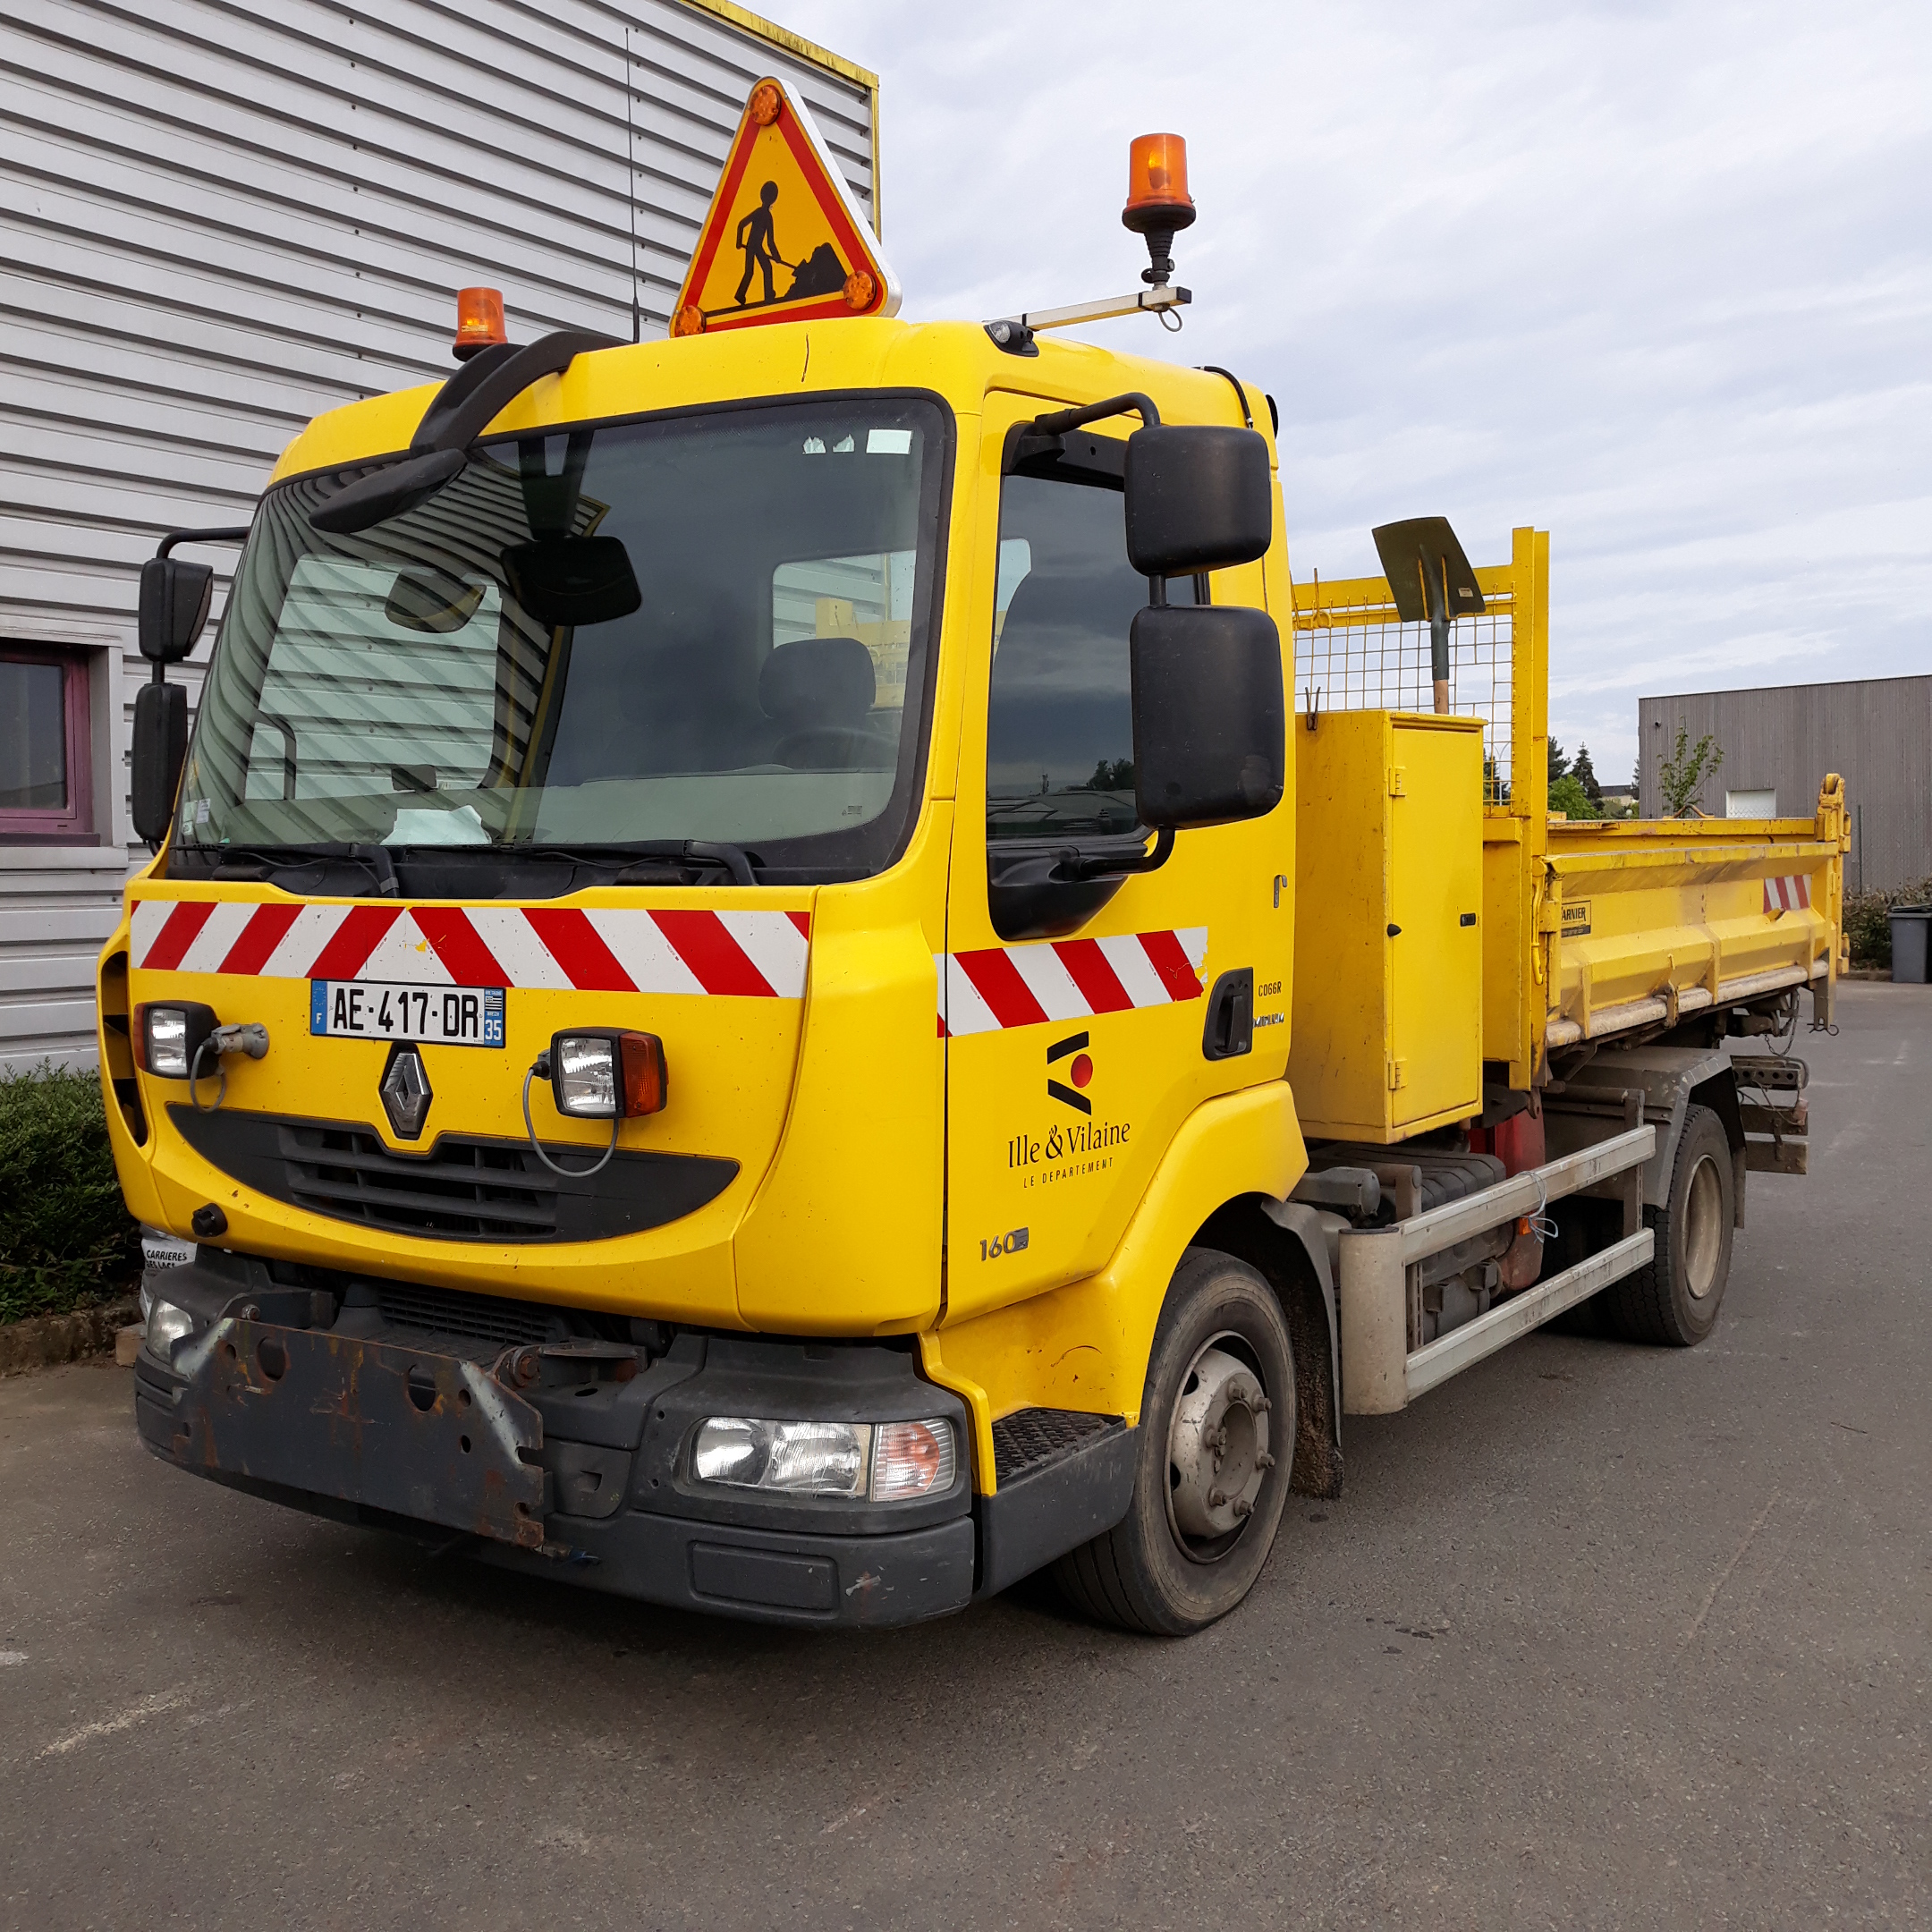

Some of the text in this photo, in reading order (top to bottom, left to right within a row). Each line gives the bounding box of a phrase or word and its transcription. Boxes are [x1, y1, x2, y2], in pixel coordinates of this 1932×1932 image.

[1561, 906, 1586, 921] ARNIER
[316, 1013, 323, 1024] F
[485, 1019, 502, 1041] 35
[1008, 1122, 1131, 1168] Ille & Vilaine
[1023, 1157, 1114, 1189] LE DEPARTEMENT
[146, 1250, 188, 1261] CARRIERES
